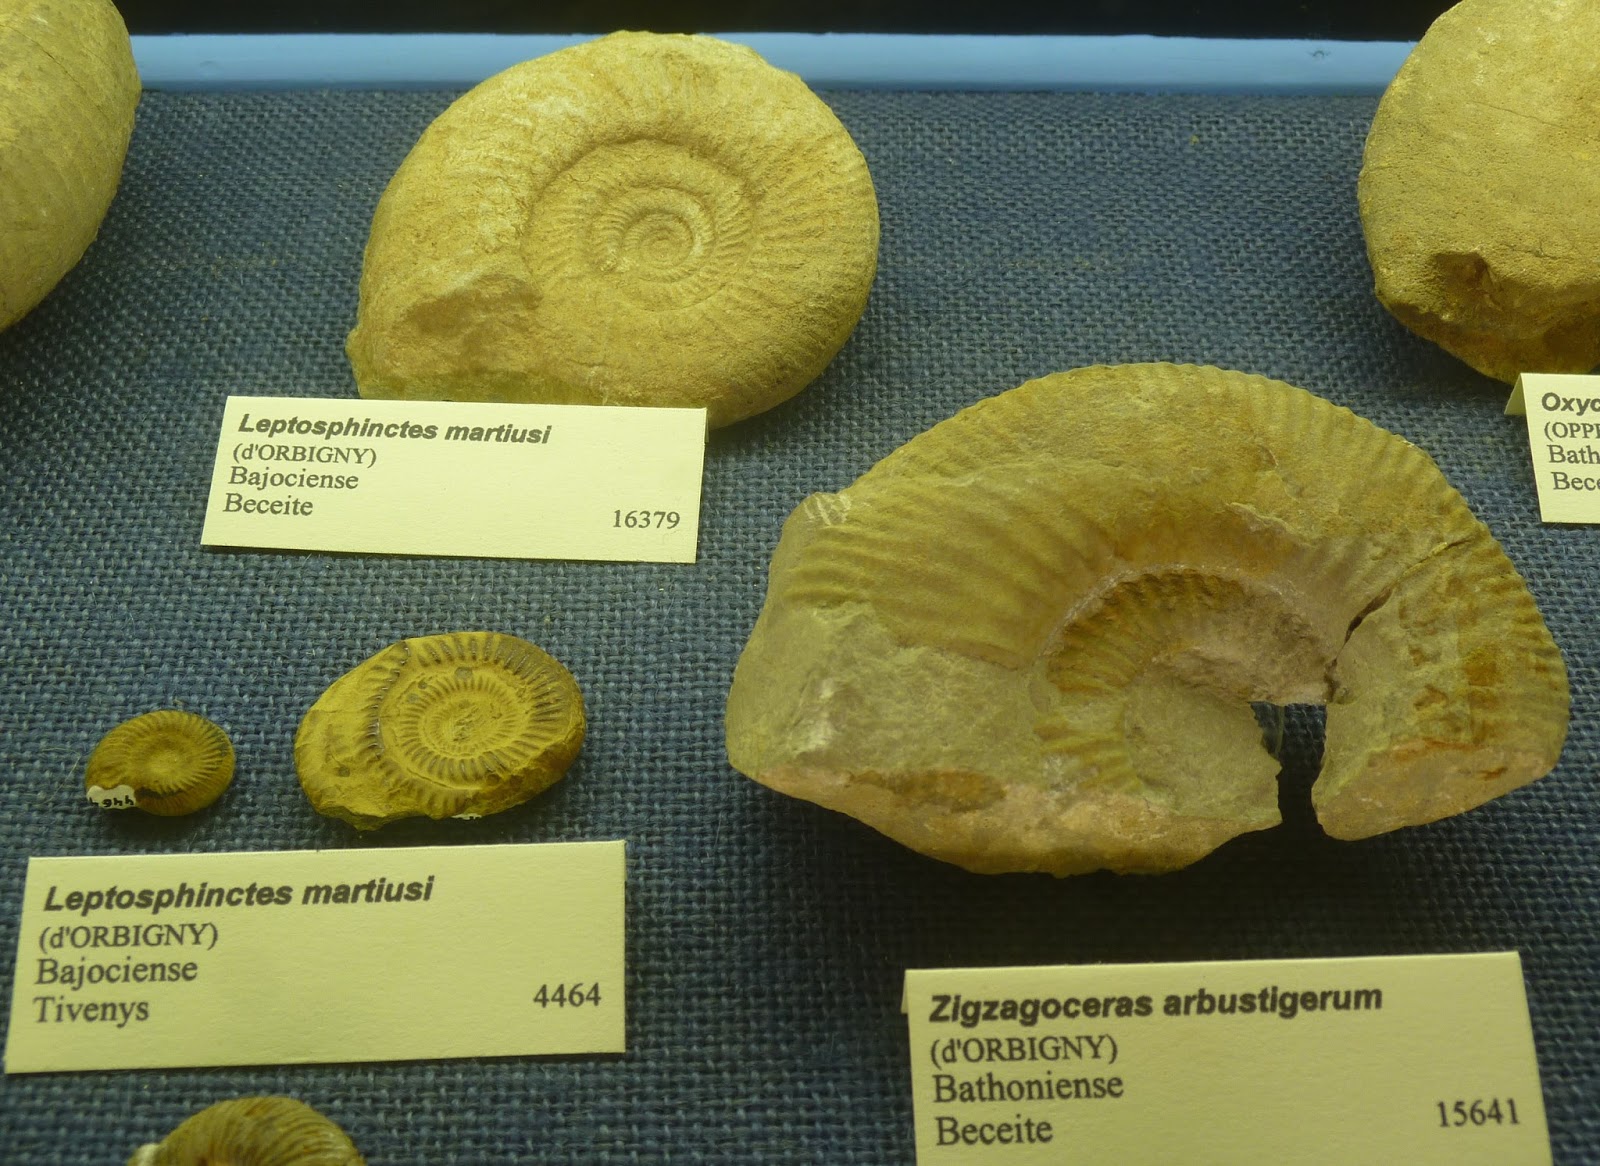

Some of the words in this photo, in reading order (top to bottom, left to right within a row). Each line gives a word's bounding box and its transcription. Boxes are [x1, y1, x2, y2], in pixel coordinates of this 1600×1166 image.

[1541, 391, 1600, 417] Oxyc
[237, 413, 439, 441] Leptosphinctes
[444, 423, 553, 444] martiusi
[232, 442, 377, 469] (d'ORBIGNY)
[1546, 444, 1600, 465] Bath
[227, 465, 359, 491] Bajociense
[222, 492, 314, 517] Beceite
[613, 509, 681, 530] 16379
[43, 882, 294, 917] Leptosphinctes
[301, 875, 435, 905] martiusi
[39, 922, 219, 954] (d'ORBIGNY)
[34, 955, 198, 992] Bajociense
[533, 982, 602, 1009] 4464
[928, 994, 1153, 1029] Zigzagoceras
[1163, 985, 1383, 1020] arbustigerum
[33, 995, 149, 1029] Tivenys
[930, 1033, 1118, 1070] (d'ORBIGNY)
[932, 1070, 1124, 1103] Bathoniense
[1437, 1098, 1519, 1128] 15641
[935, 1113, 1054, 1146] Beceite
